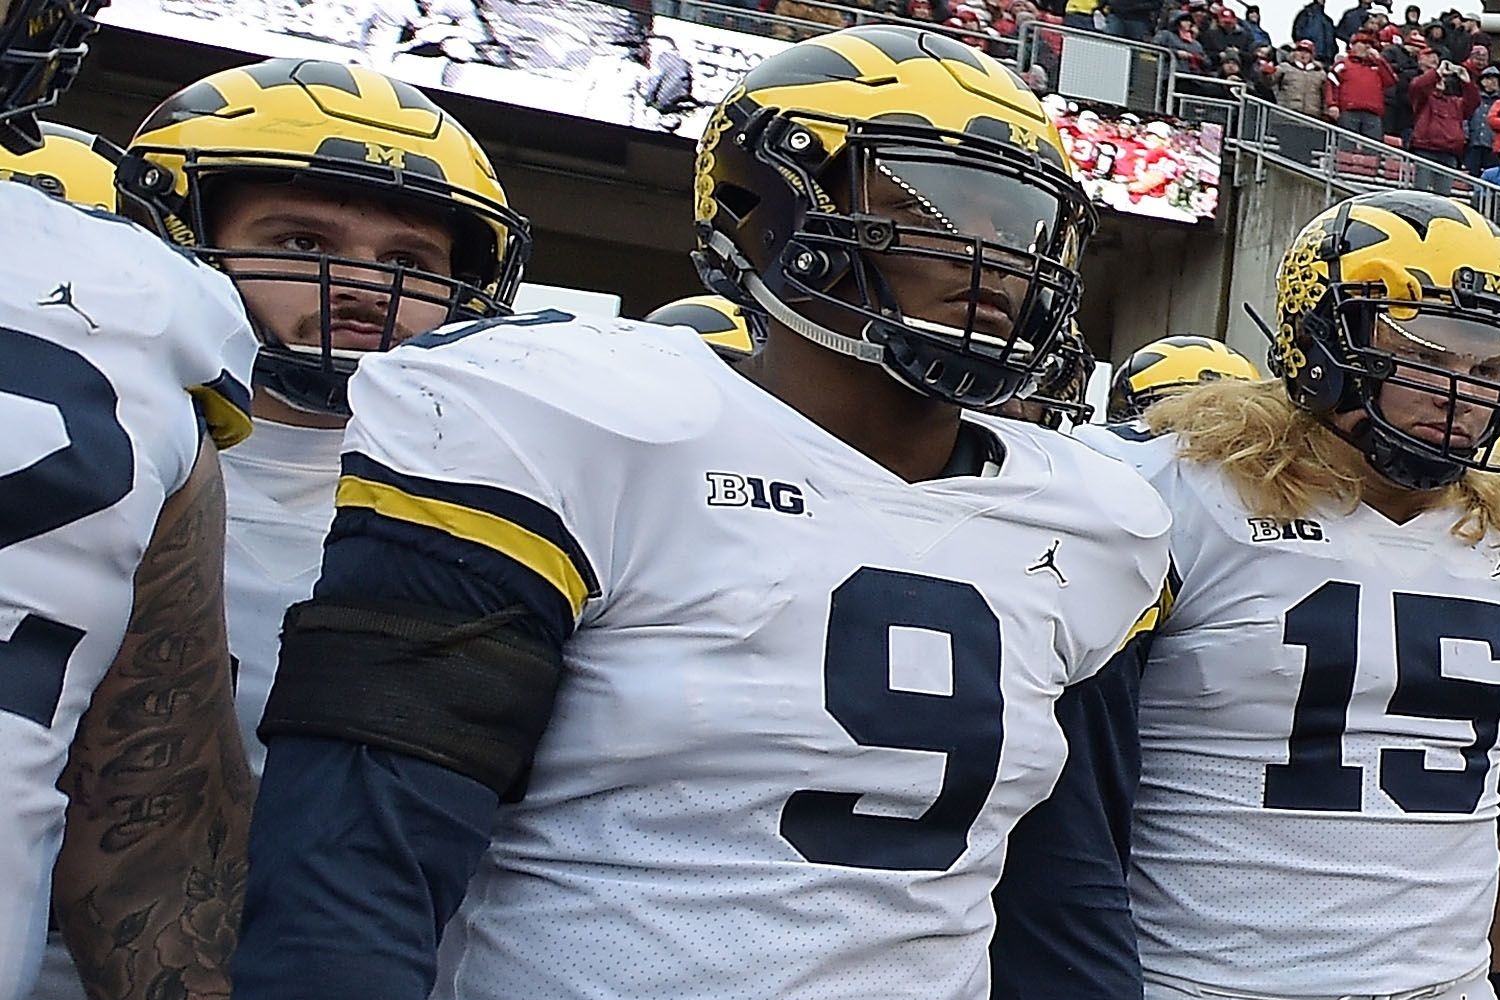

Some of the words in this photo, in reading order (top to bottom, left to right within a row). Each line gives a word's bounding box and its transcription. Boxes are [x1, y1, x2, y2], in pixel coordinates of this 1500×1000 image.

[1008, 123, 1040, 152] M
[365, 142, 405, 169] M
[780, 565, 1005, 871] 9
